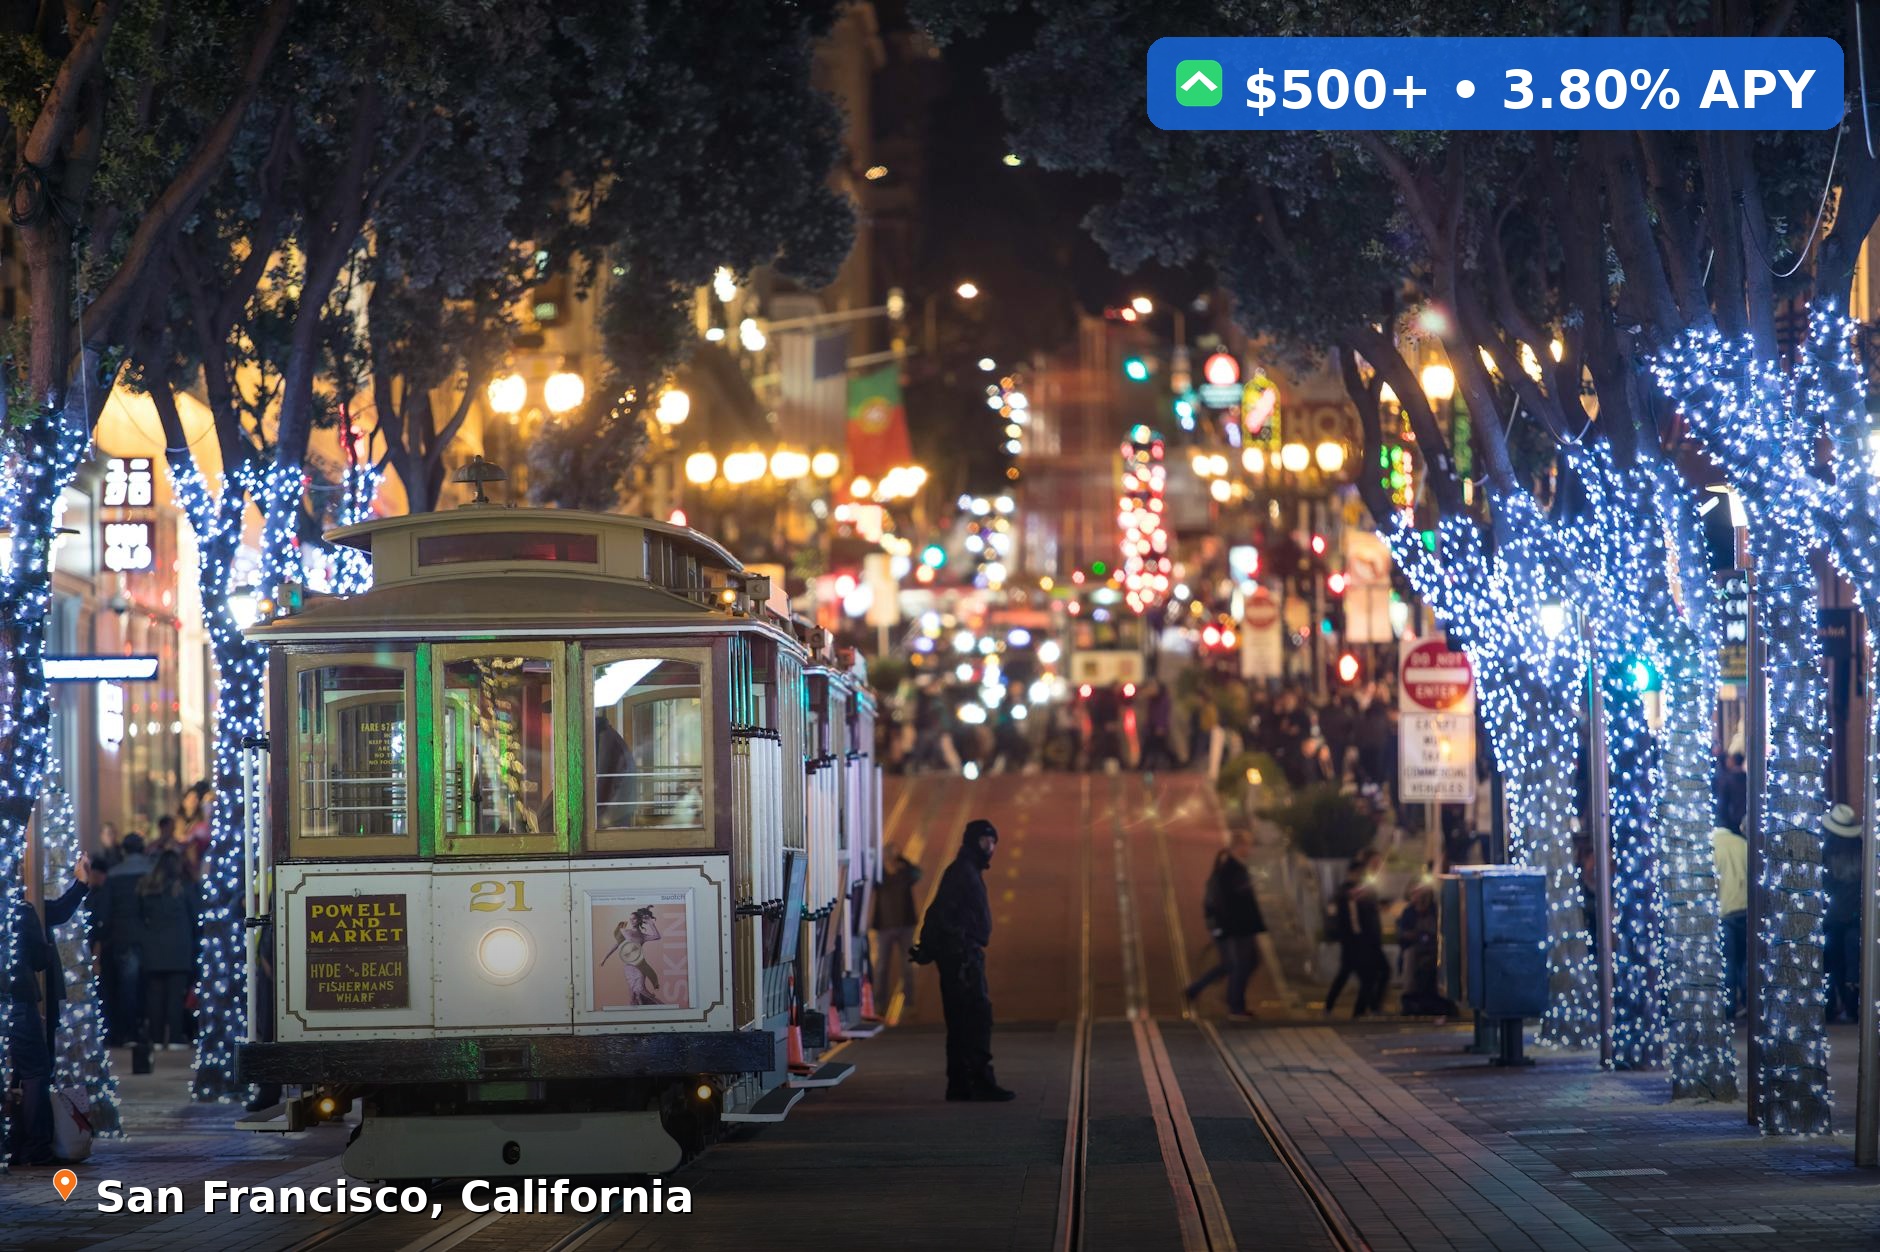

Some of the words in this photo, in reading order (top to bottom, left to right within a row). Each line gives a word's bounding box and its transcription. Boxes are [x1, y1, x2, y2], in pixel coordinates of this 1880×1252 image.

[1410, 652, 1431, 666] DO
[1436, 652, 1462, 667] NOT
[1415, 684, 1458, 699] ENTER
[470, 880, 532, 912] 21
[311, 902, 401, 918] POWELL
[336, 917, 380, 929] AND
[310, 928, 403, 944] MARKET
[662, 911, 689, 1004] SKIN
[310, 963, 341, 978] HYDE
[361, 961, 402, 977] BEACH
[318, 980, 394, 993] FISHERMANS
[336, 992, 376, 1003] WHARF
